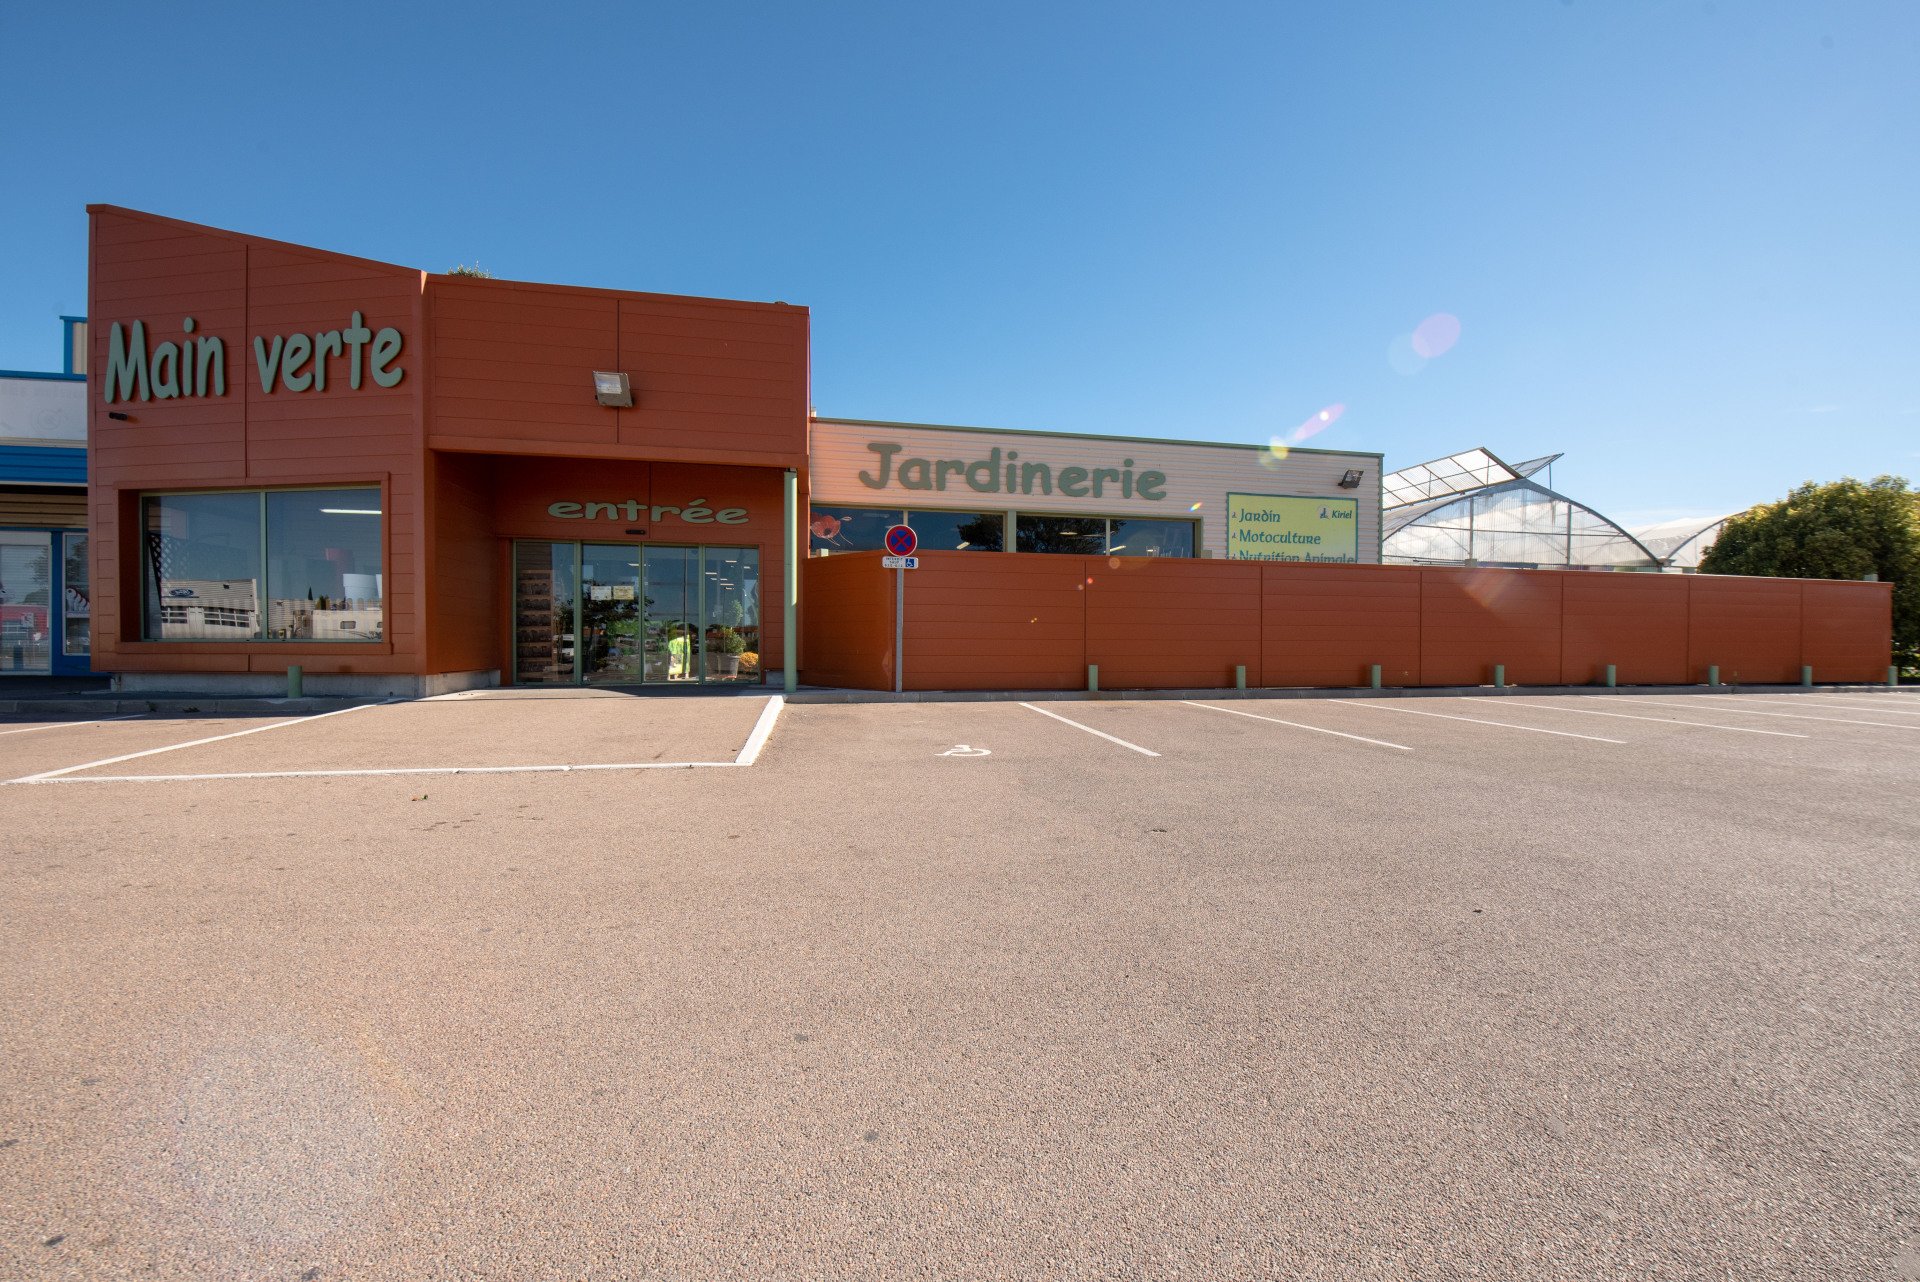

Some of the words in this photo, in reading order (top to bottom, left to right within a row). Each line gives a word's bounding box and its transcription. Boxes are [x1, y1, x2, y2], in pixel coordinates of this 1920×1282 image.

[104, 317, 225, 404] Main
[253, 310, 404, 394] verte
[858, 442, 1167, 500] Jardinerie
[547, 498, 749, 525] entrée
[1239, 508, 1280, 523] Jardin
[1331, 510, 1353, 519] Kiriel
[1239, 529, 1321, 545] Motoculture
